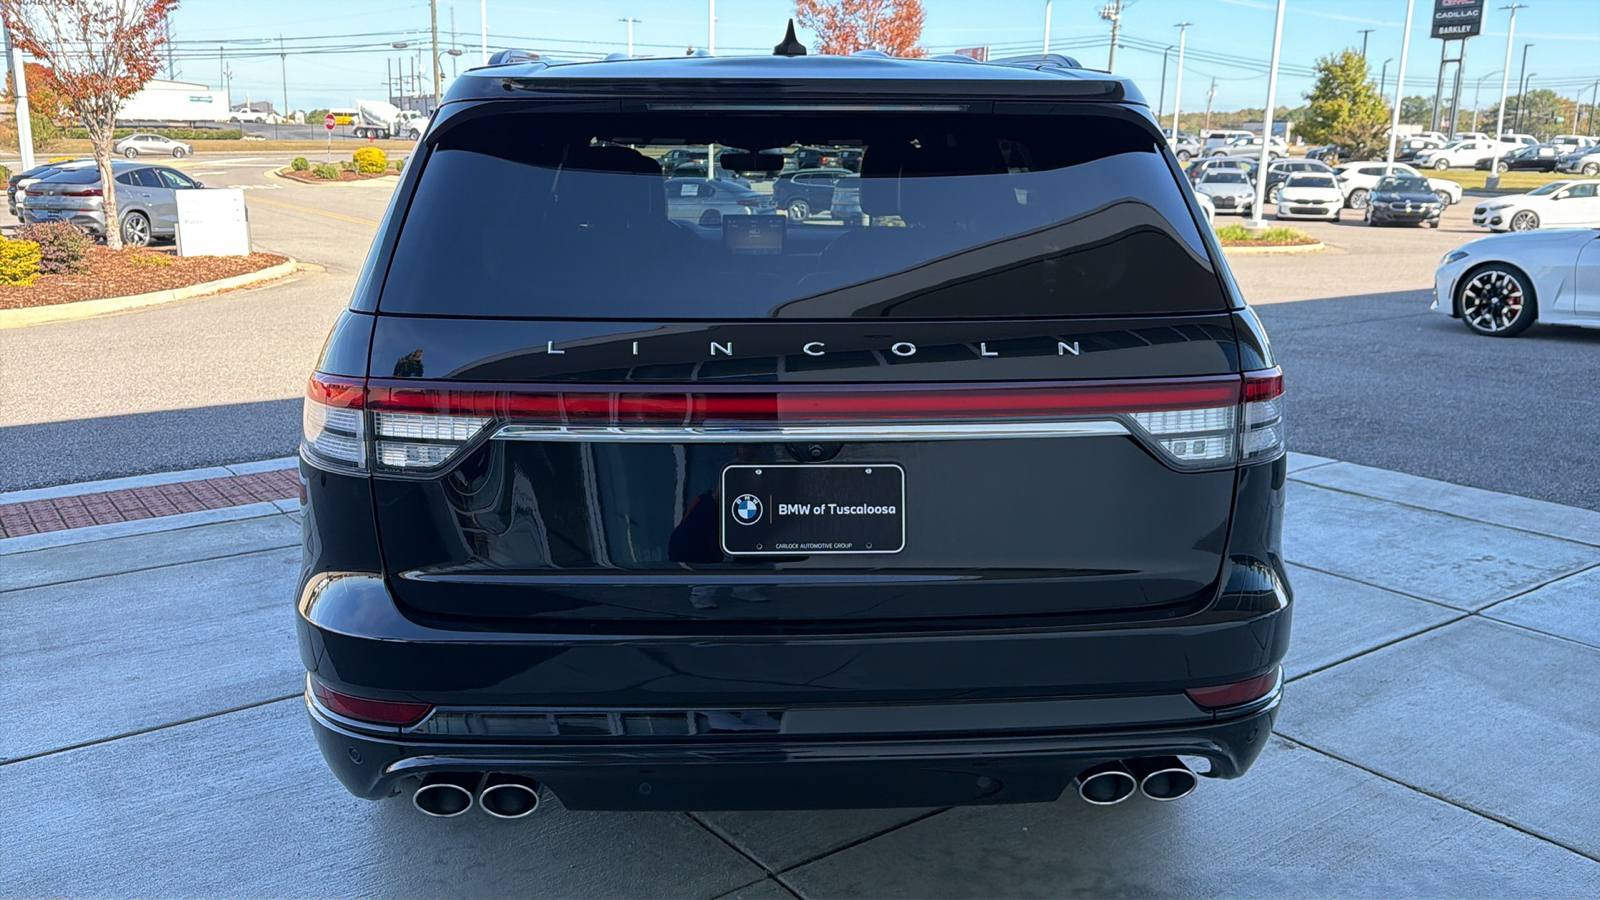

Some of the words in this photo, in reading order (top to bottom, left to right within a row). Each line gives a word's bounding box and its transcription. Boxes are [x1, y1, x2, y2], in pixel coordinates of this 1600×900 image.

[1435, 9, 1480, 19] CADILLAC
[1438, 25, 1472, 34] BARKLEY
[547, 340, 1080, 356] LINCOLN
[778, 504, 811, 515] BMW
[813, 503, 826, 515] of
[828, 503, 896, 515] Tuscaloosa
